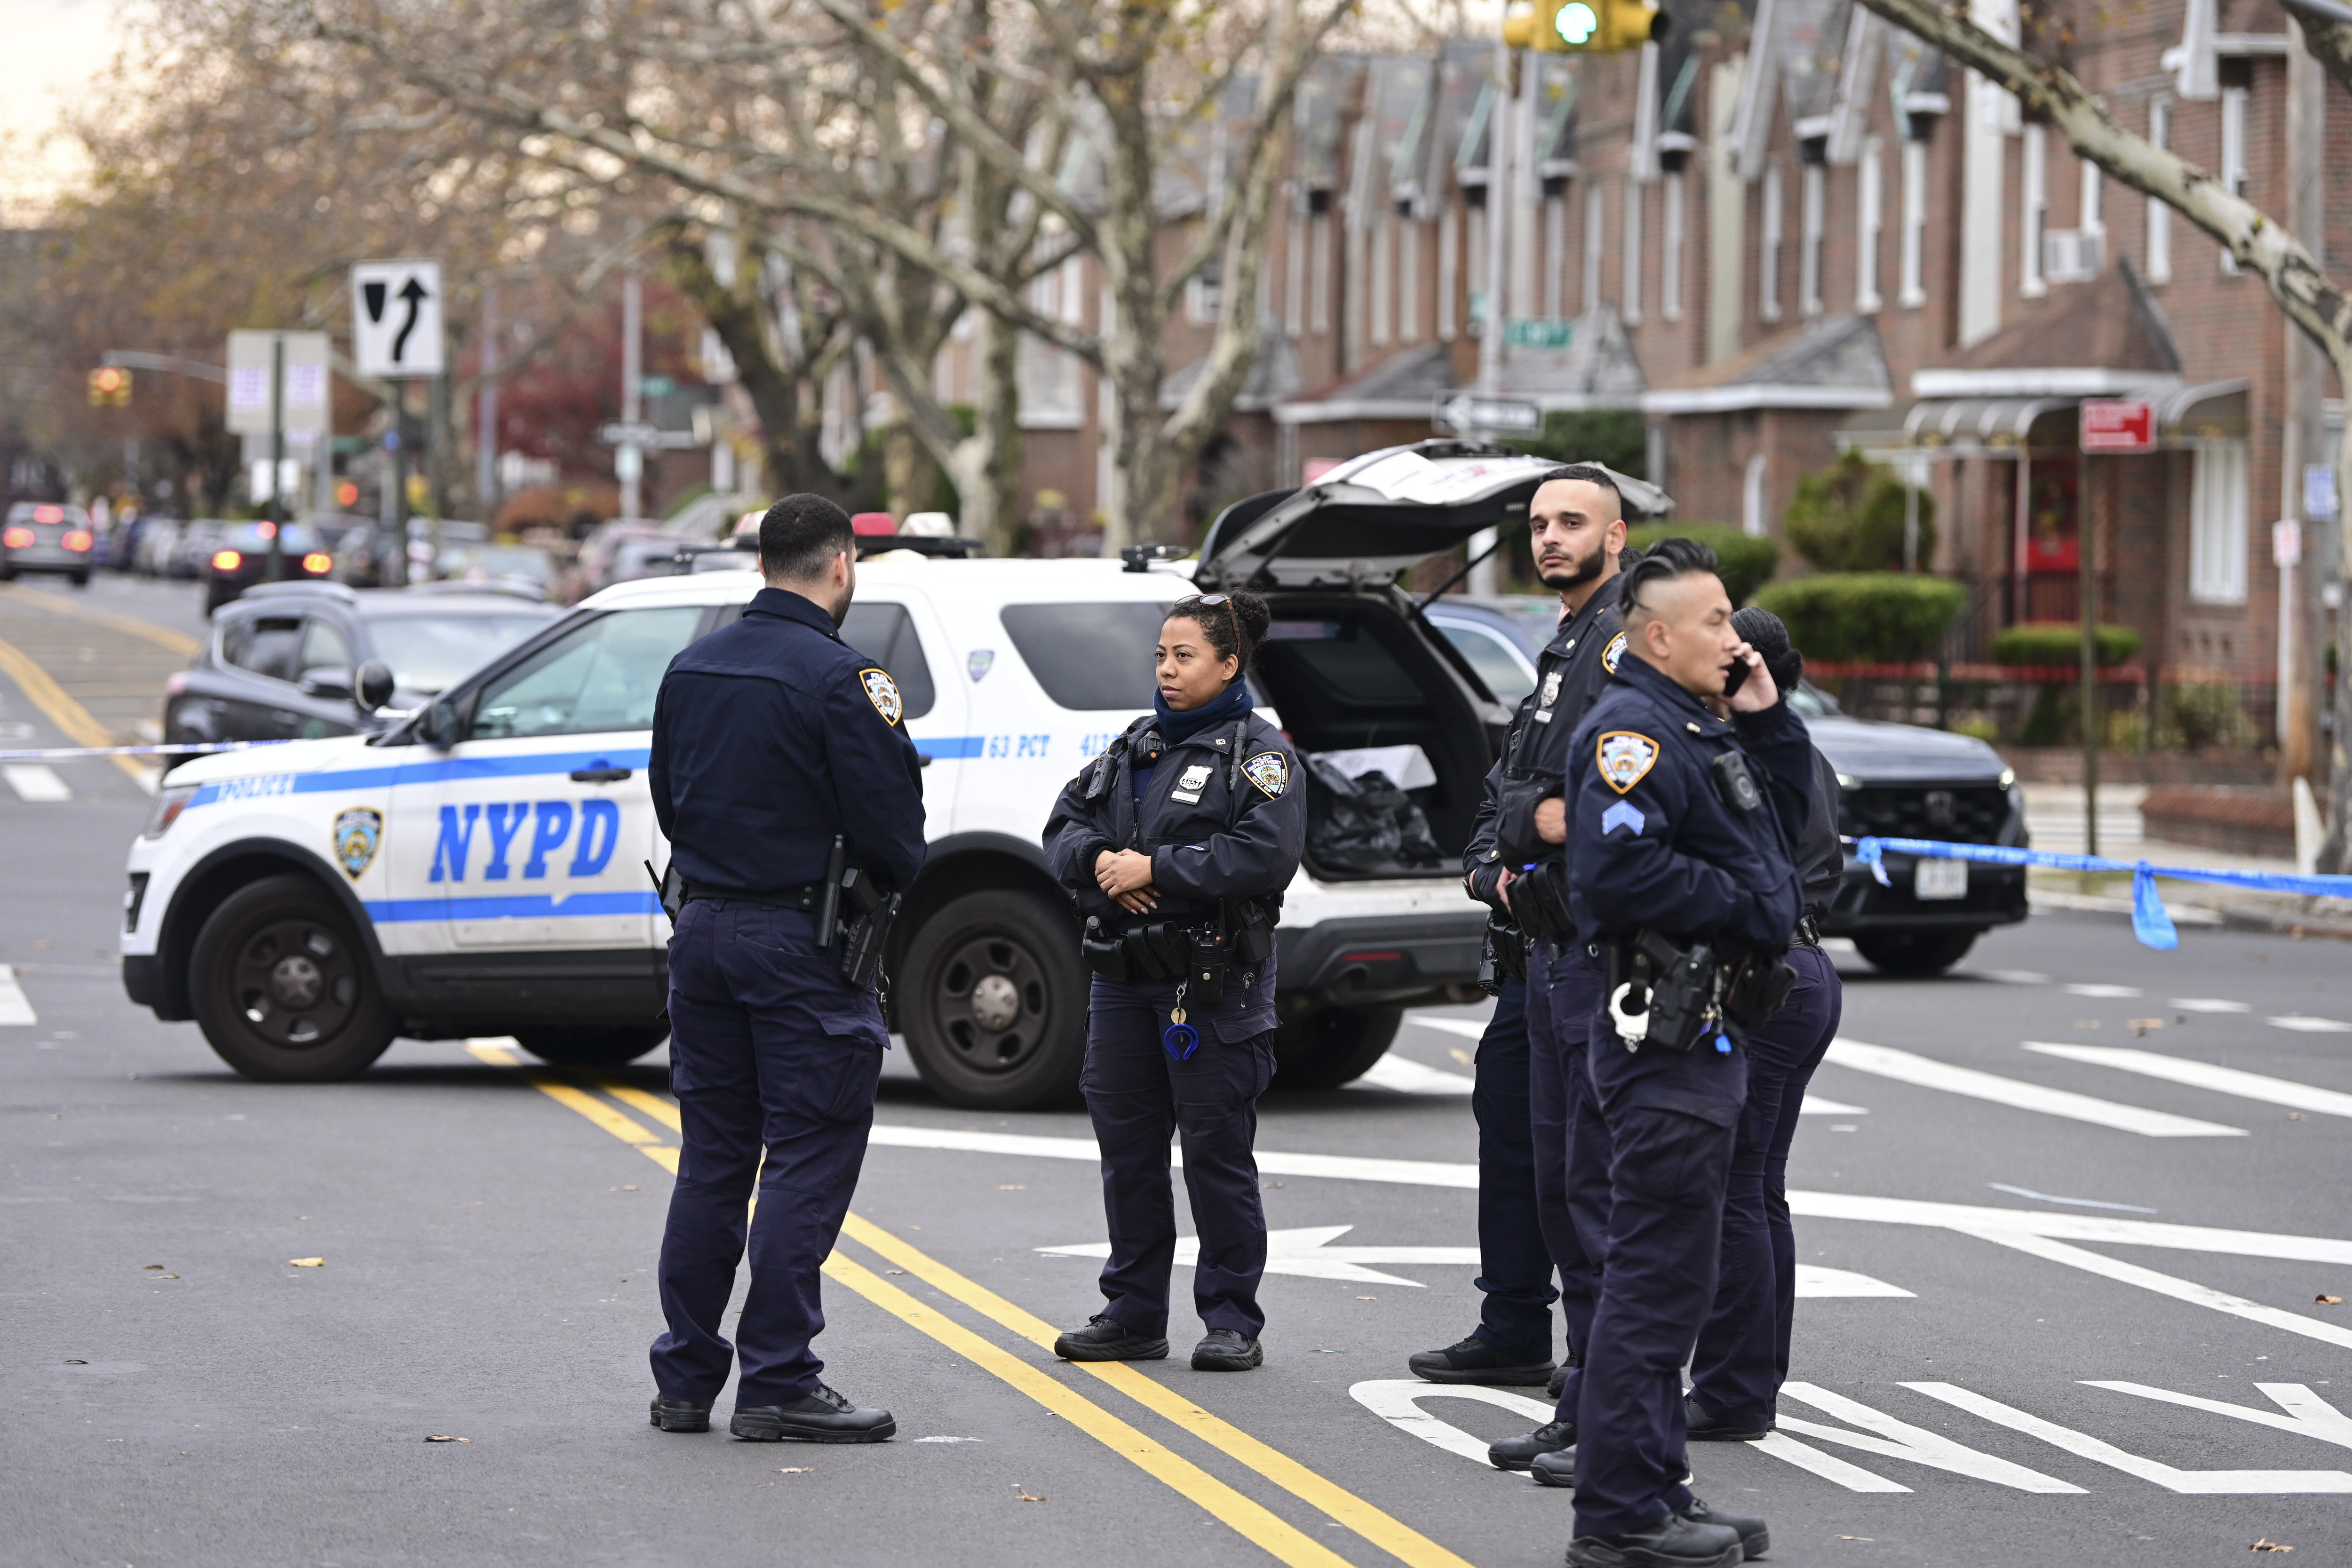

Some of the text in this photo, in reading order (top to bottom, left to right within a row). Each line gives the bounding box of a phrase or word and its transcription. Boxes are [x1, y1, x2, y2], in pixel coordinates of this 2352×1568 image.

[989, 735, 1009, 757] 63
[1017, 734, 1050, 757] PCT
[1251, 755, 1273, 764] POLICE
[1247, 760, 1281, 772] DEPARTMENT
[1252, 776, 1264, 786] CITY
[429, 799, 620, 883] NYPD
